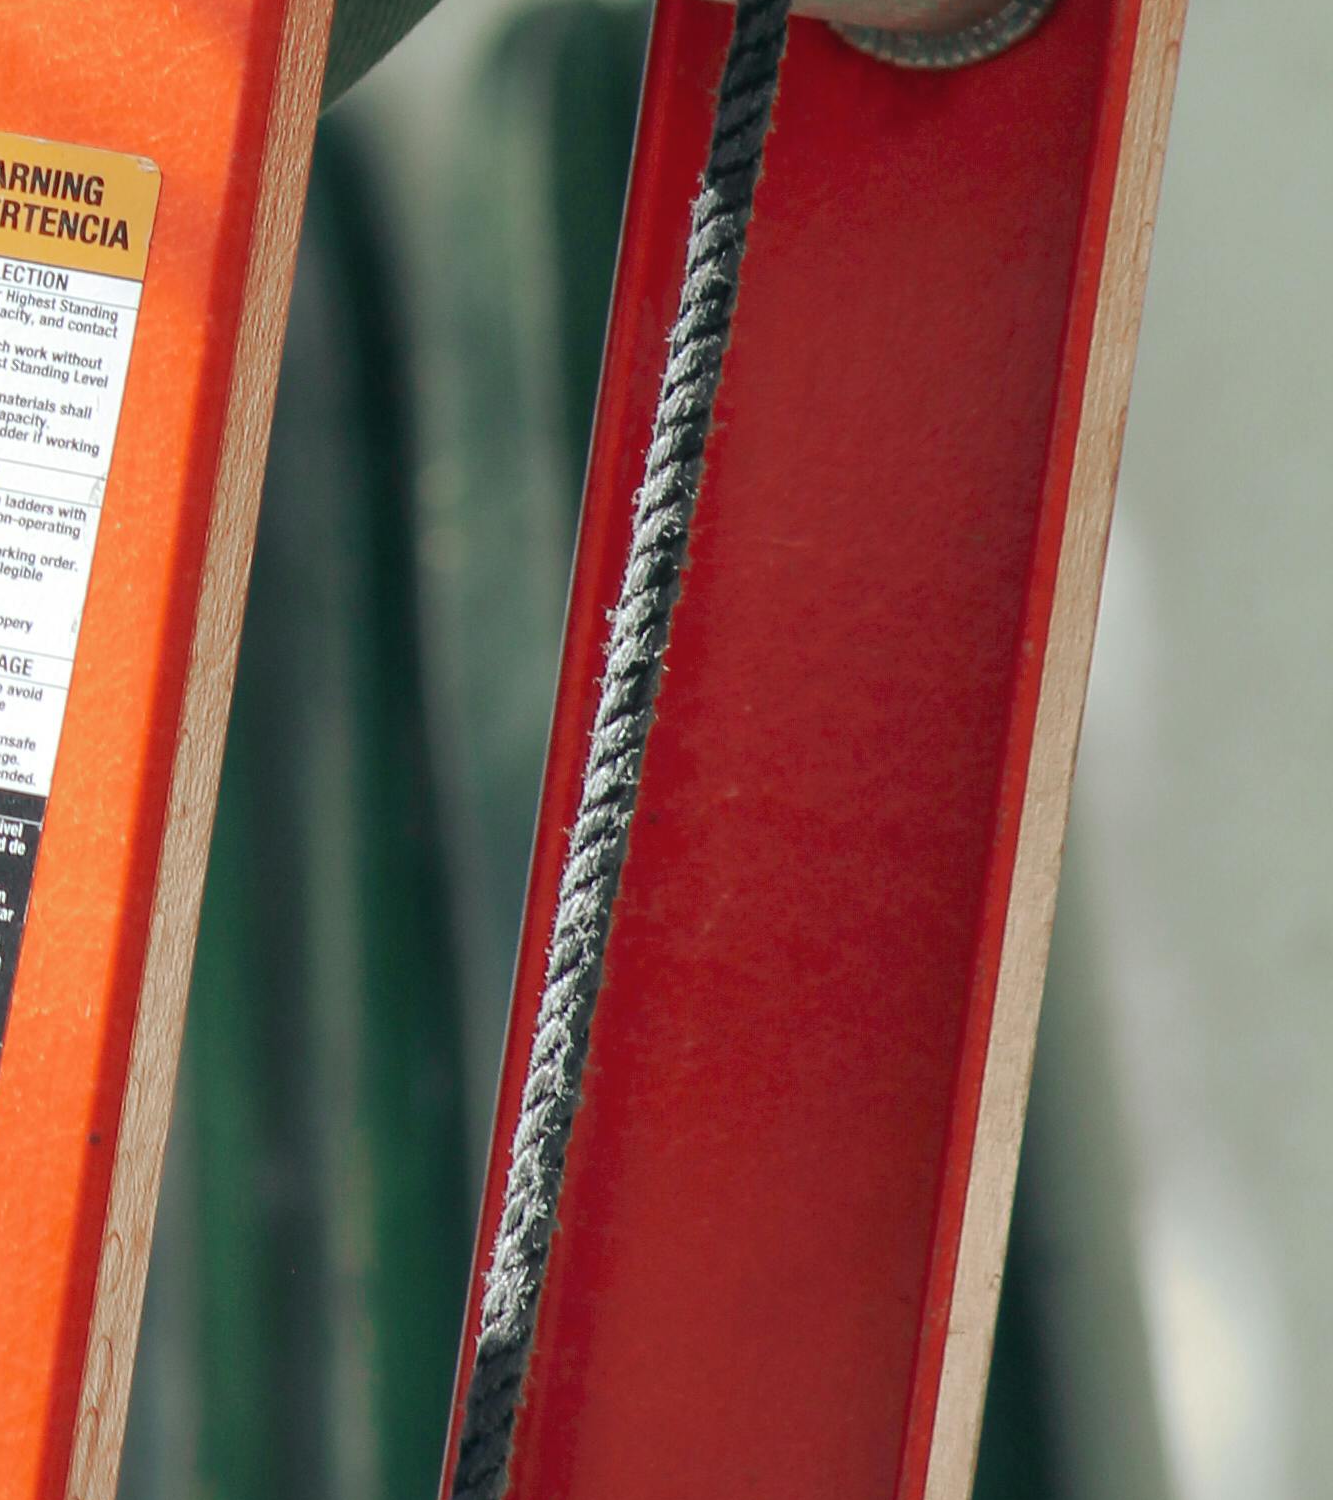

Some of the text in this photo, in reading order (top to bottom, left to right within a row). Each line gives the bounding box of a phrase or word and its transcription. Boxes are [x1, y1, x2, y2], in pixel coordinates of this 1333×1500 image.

[5, 290, 56, 312] Highest
[58, 300, 119, 324] Standing
[38, 313, 64, 328] and
[67, 318, 118, 338] contact
